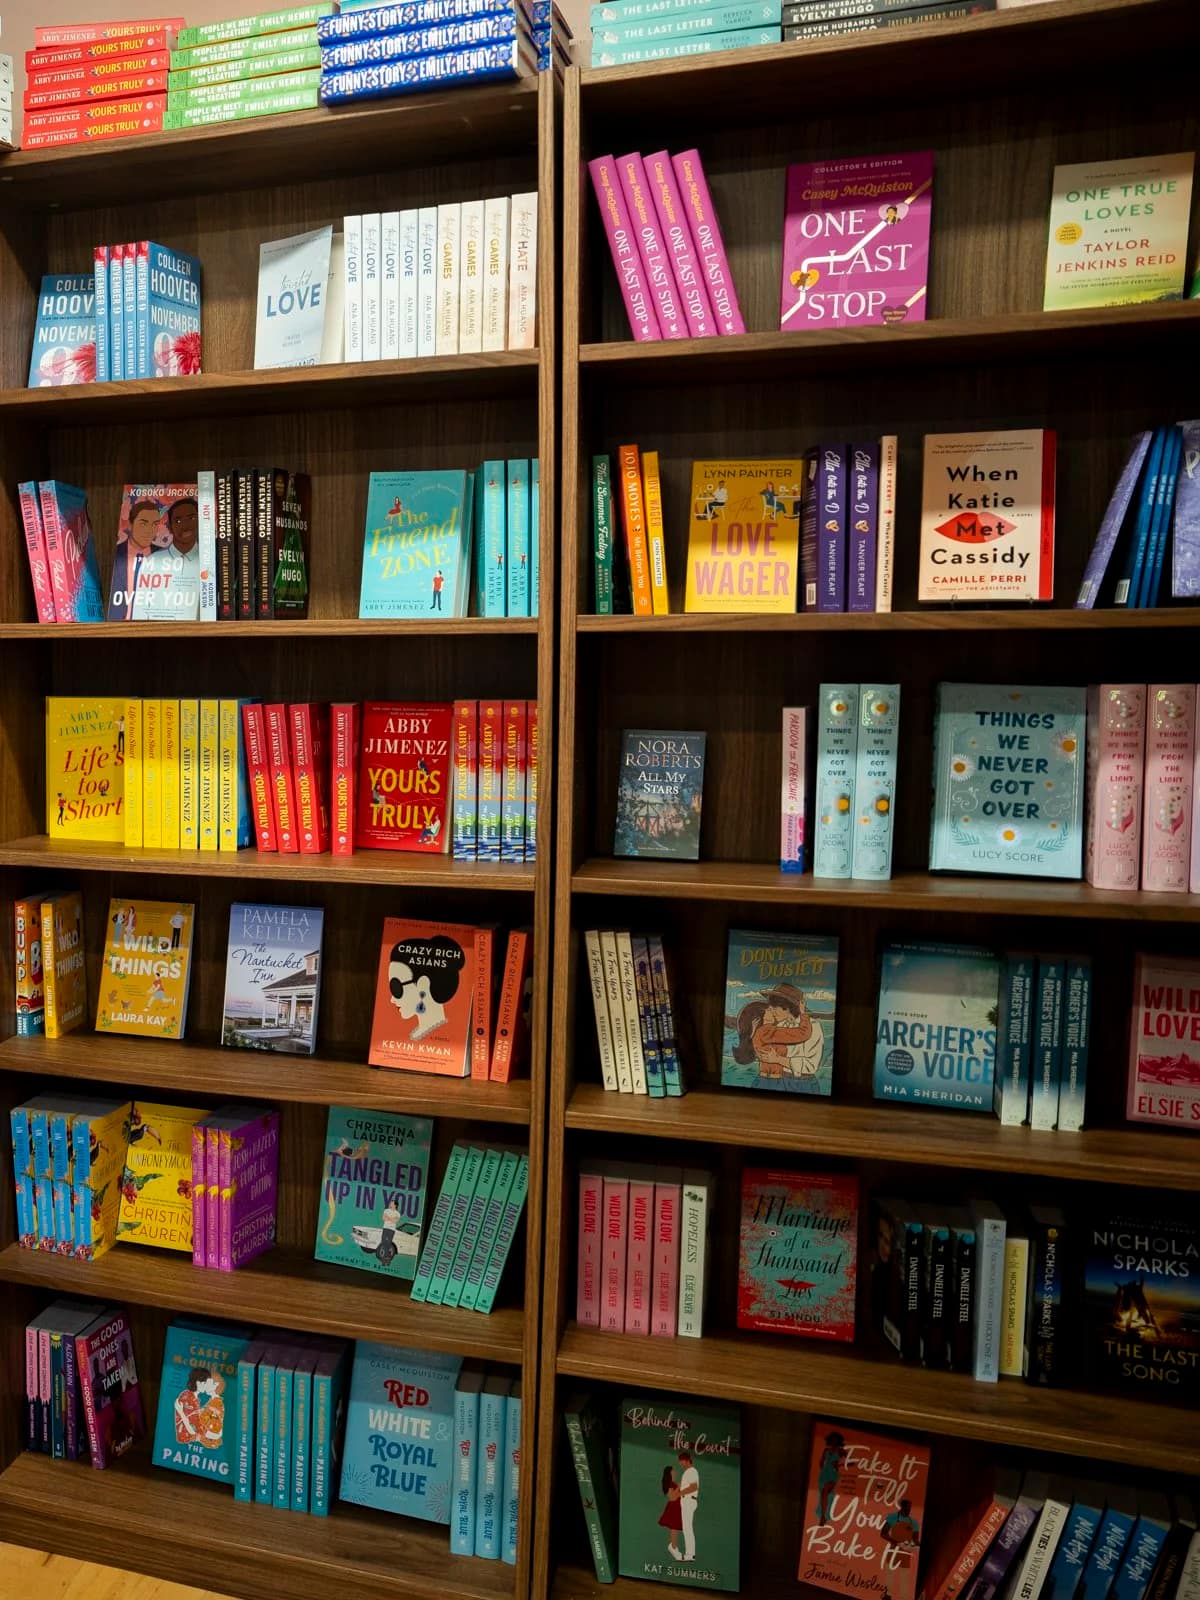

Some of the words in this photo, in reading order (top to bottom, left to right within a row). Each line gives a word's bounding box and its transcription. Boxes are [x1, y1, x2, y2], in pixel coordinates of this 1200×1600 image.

[422, 27, 455, 49] EMILY
[458, 20, 494, 42] HENRY
[334, 43, 369, 64] FUNNY
[371, 37, 406, 58] STORY
[815, 163, 867, 174] COLLECTOR'S
[870, 160, 903, 168] EDITION
[802, 188, 839, 200] Casey
[840, 181, 913, 197] McQuiston
[1066, 188, 1111, 203] ONE
[1120, 181, 1177, 198] TRUE
[1084, 203, 1155, 221] LOVES
[800, 209, 867, 239] ONE
[489, 238, 499, 276] GAMES
[1084, 239, 1150, 253] TAYLOR
[157, 252, 191, 276] COLLEEN
[828, 244, 912, 275] LAST
[1056, 258, 1128, 274] JENKINS
[1136, 254, 1176, 266] REID
[151, 268, 198, 305] HOOVER
[266, 282, 321, 318] LOVE
[807, 291, 887, 320] STOP
[151, 304, 199, 333] NOVEMBER
[704, 469, 737, 479] LYNN
[739, 468, 792, 478] PAINTER
[946, 464, 1018, 482] When
[129, 488, 165, 497] KOSOKO
[948, 492, 1015, 510] Katie
[275, 517, 307, 530] HUSBANDS
[370, 507, 459, 557] Friend
[956, 520, 1006, 537] Met
[710, 523, 779, 557] LOVE
[278, 549, 304, 563] EVELYN
[380, 543, 451, 579] ZONE
[931, 546, 1030, 568] Cassidy
[139, 574, 173, 588] NOT
[281, 570, 302, 581] HUGO
[695, 561, 790, 596] WAGER
[932, 575, 985, 584] CAMILLE
[990, 575, 1027, 583] PERRI
[113, 591, 155, 606] OVER
[160, 591, 196, 606] YOU
[384, 717, 432, 734] ABBY
[975, 711, 1055, 729] THINGS
[364, 739, 448, 756] JIMENEZ
[638, 739, 690, 755] NORA
[998, 734, 1030, 751] WE
[63, 744, 125, 776] Life's
[624, 752, 701, 769] ROBERTS
[978, 755, 1048, 774] NEVER
[78, 772, 110, 796] too
[368, 768, 441, 795] YOURS
[638, 770, 663, 782] ALL
[990, 778, 1035, 796] GOT
[643, 783, 679, 795] STARS
[65, 797, 123, 821] Short
[370, 802, 436, 830] TRULY
[982, 801, 1040, 819] OVER
[972, 850, 1001, 861] LUCY
[1005, 851, 1045, 863] SCORE
[242, 908, 311, 927] PAMELA
[123, 934, 172, 953] WILD
[242, 924, 311, 943] KELLEY
[231, 947, 304, 970] Nantucket
[398, 944, 433, 958] CRAZY
[435, 948, 461, 960] RICH
[408, 956, 448, 968] ASIANS
[110, 956, 181, 979] THINGS
[111, 1012, 144, 1023] LAURA
[146, 1013, 167, 1025] KAY
[381, 1039, 416, 1053] KEVIN
[419, 1043, 452, 1056] KWAN
[877, 1018, 997, 1057] ARCHER'S
[923, 1051, 993, 1085] VOICE
[883, 1084, 908, 1097] MIA
[913, 1089, 984, 1105] SHERIDAN
[346, 1119, 415, 1140] CHRISTINA
[353, 1130, 404, 1147] LAUREN
[329, 1152, 422, 1192] TANGLED
[326, 1180, 350, 1204] UP
[355, 1184, 376, 1211] IN
[382, 1189, 420, 1219] YOU
[752, 1195, 851, 1239] Marriage
[687, 1207, 699, 1264] HOPELESS
[756, 1242, 842, 1276] Thousand
[1113, 1254, 1190, 1278] SPARKS
[100, 1319, 124, 1342] GOOD
[99, 1339, 119, 1358] ONES
[1103, 1340, 1145, 1359] THE
[1152, 1342, 1200, 1368] LAST
[102, 1366, 128, 1391] TAKEN
[1122, 1362, 1180, 1385] SONG
[383, 1379, 429, 1408] RED
[368, 1407, 432, 1440] WHITE
[626, 1407, 675, 1429] Behind
[162, 1448, 230, 1476] PAIRING
[368, 1434, 437, 1468] ROYAL
[844, 1445, 893, 1474] Fake
[900, 1454, 929, 1481] It
[371, 1463, 427, 1496] BLUE
[858, 1474, 908, 1510] Till
[829, 1495, 887, 1534] You
[806, 1525, 876, 1560] Bake
[881, 1543, 913, 1571] It
[644, 1563, 662, 1573] KAT
[667, 1567, 716, 1581] SUMMERS
